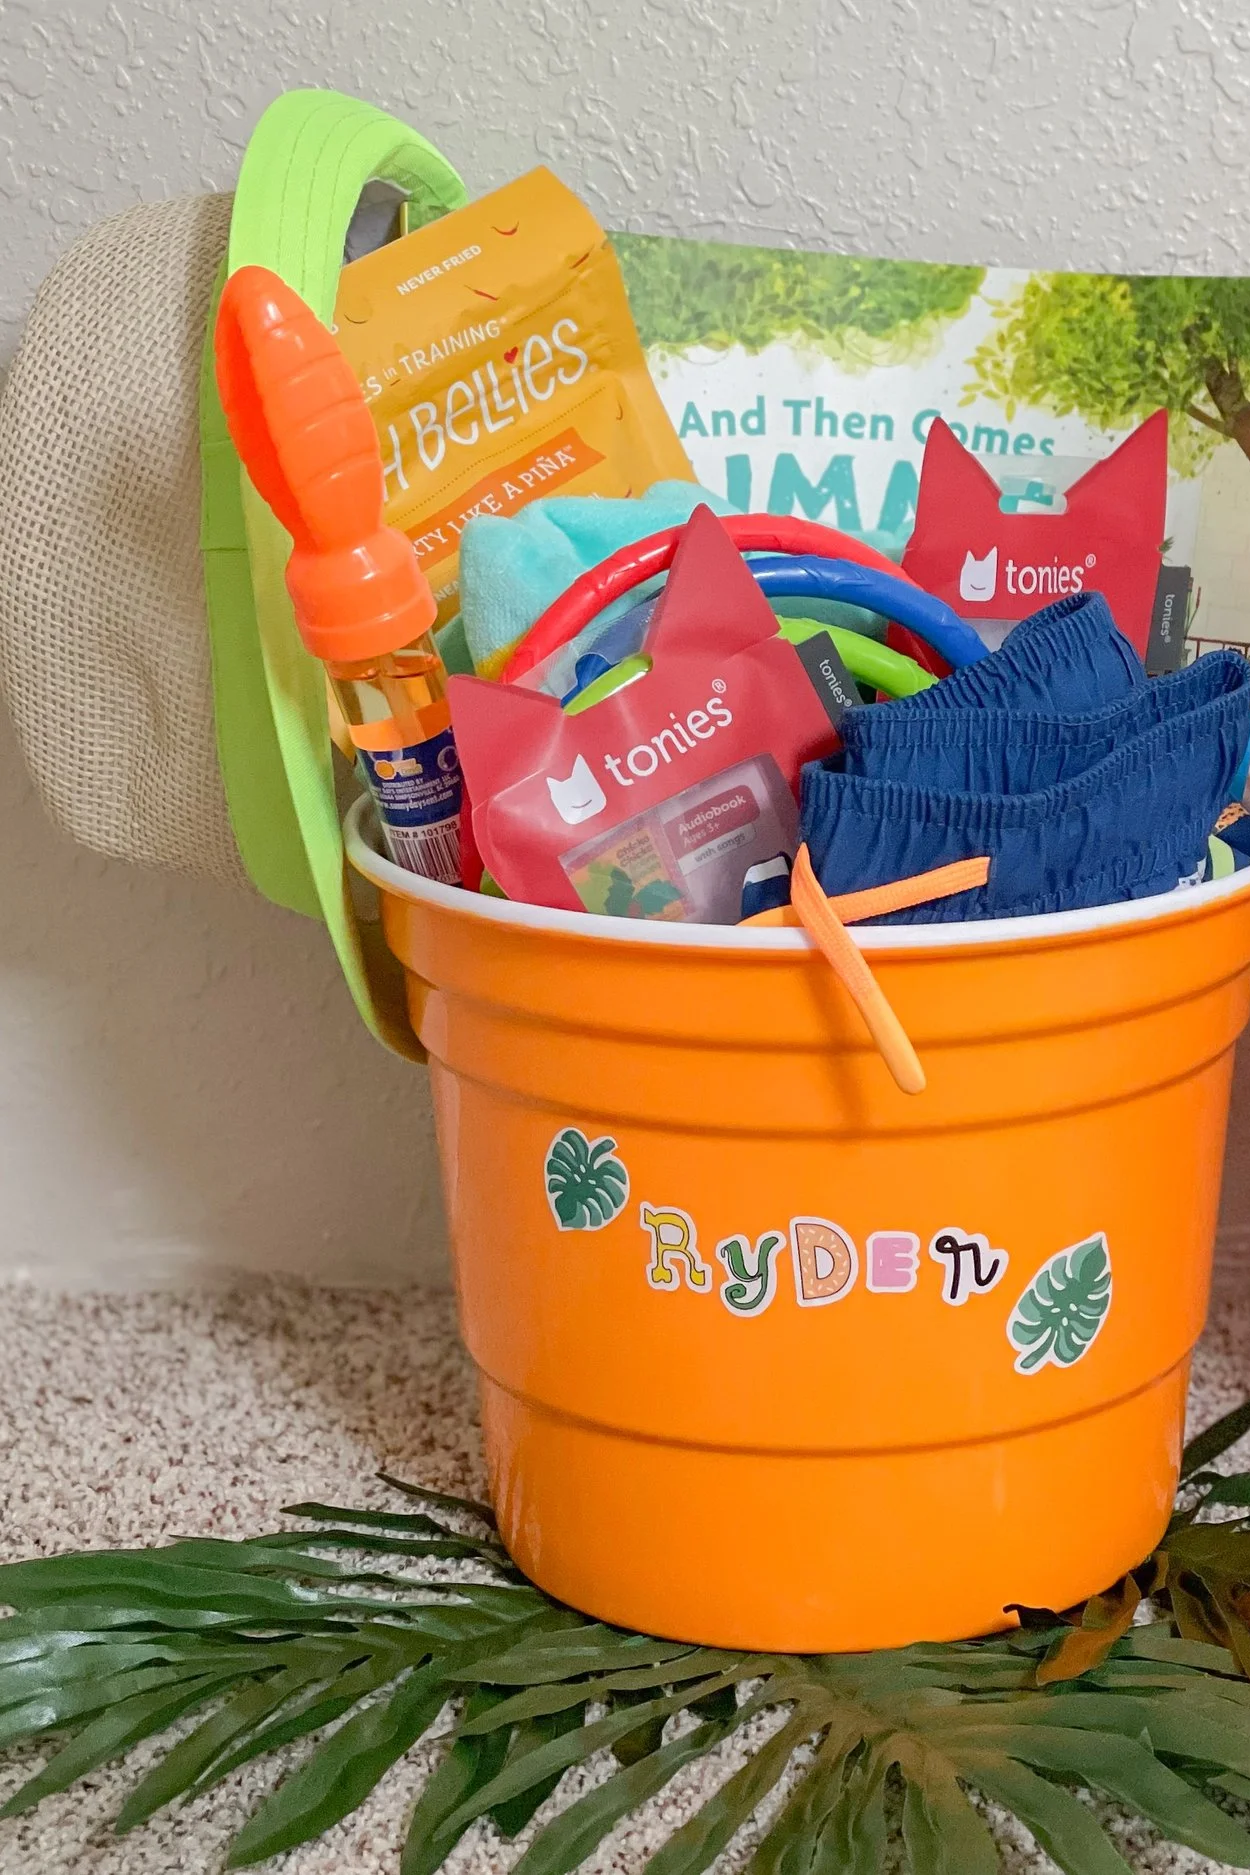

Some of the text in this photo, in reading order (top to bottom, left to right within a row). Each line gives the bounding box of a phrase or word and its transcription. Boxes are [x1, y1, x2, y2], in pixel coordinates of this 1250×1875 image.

[396, 244, 483, 296] NEVER FRIED
[678, 394, 767, 439] And
[782, 395, 895, 442] Then
[501, 480, 524, 501] A
[420, 820, 458, 838] 101798
[678, 793, 748, 836] Audiobook
[694, 832, 746, 863] with songs
